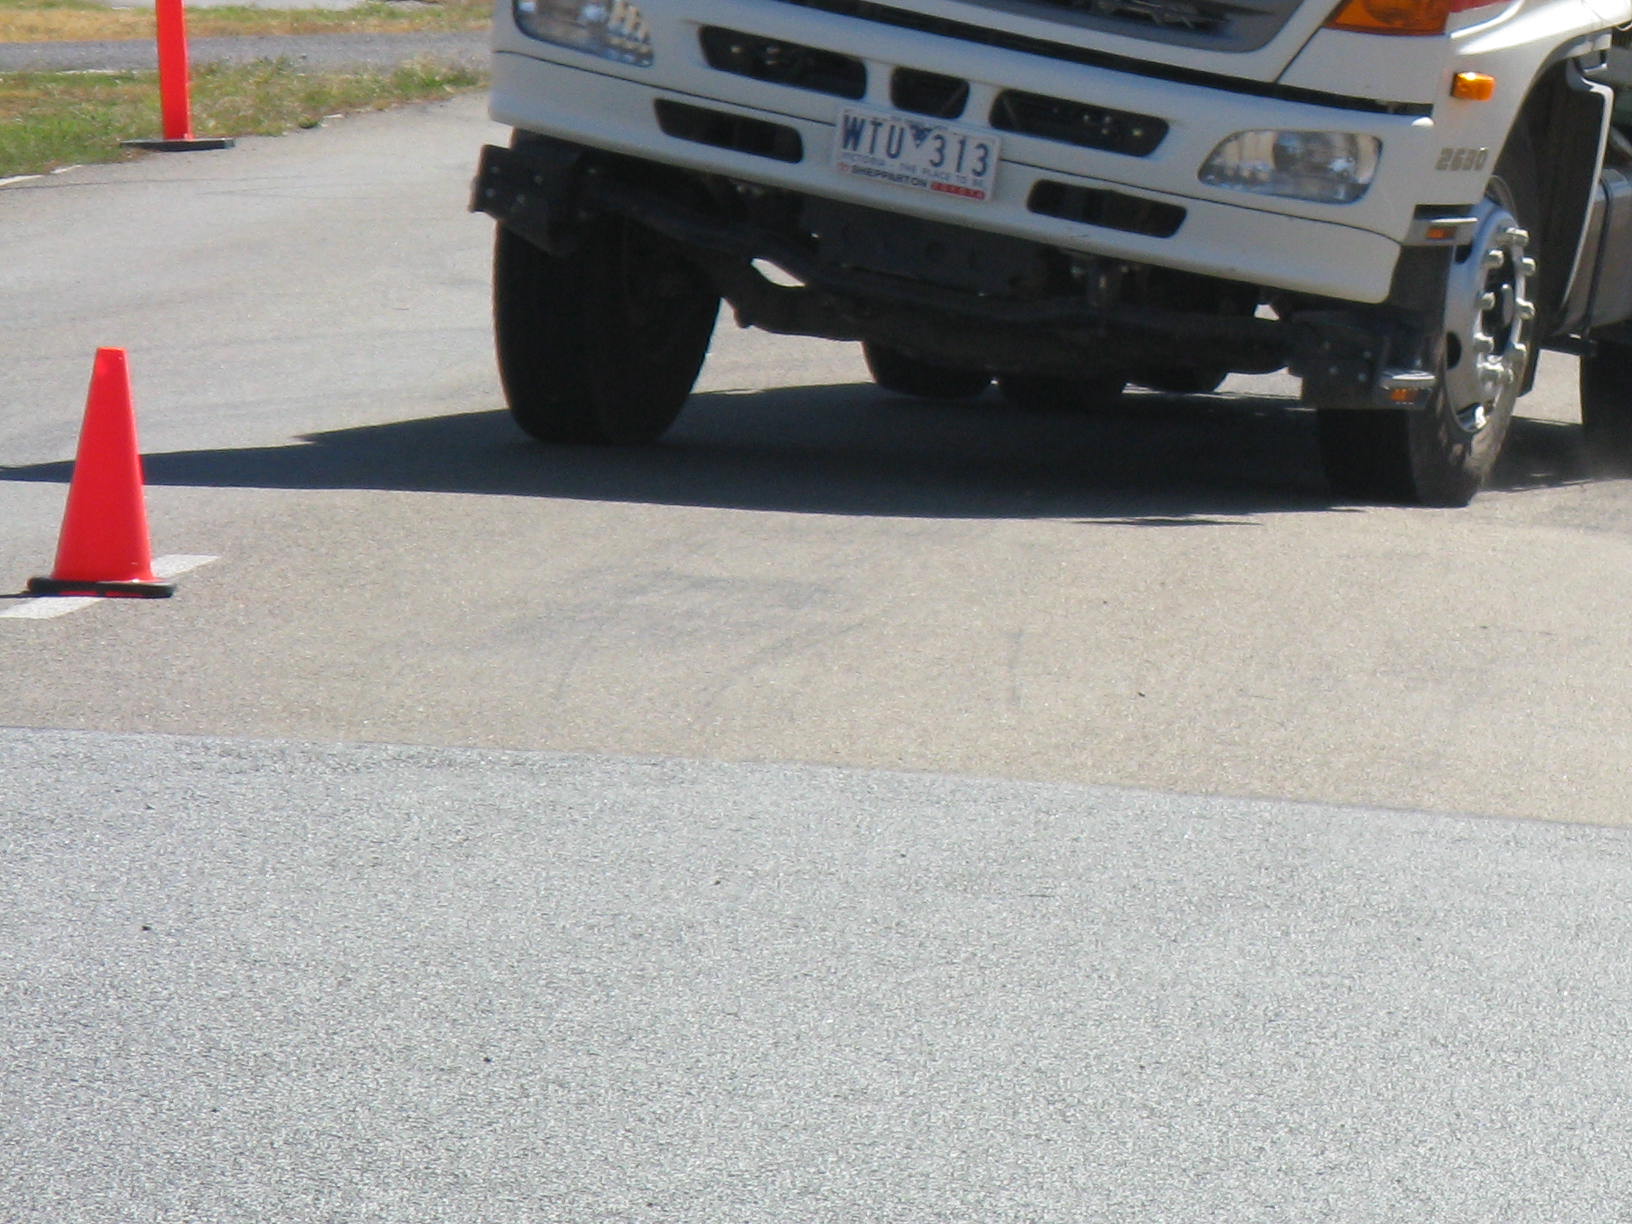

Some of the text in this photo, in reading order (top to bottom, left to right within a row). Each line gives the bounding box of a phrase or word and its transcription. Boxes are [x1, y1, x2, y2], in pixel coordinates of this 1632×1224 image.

[842, 114, 989, 177] WTU 313
[850, 164, 928, 188] SHEPPARTON
